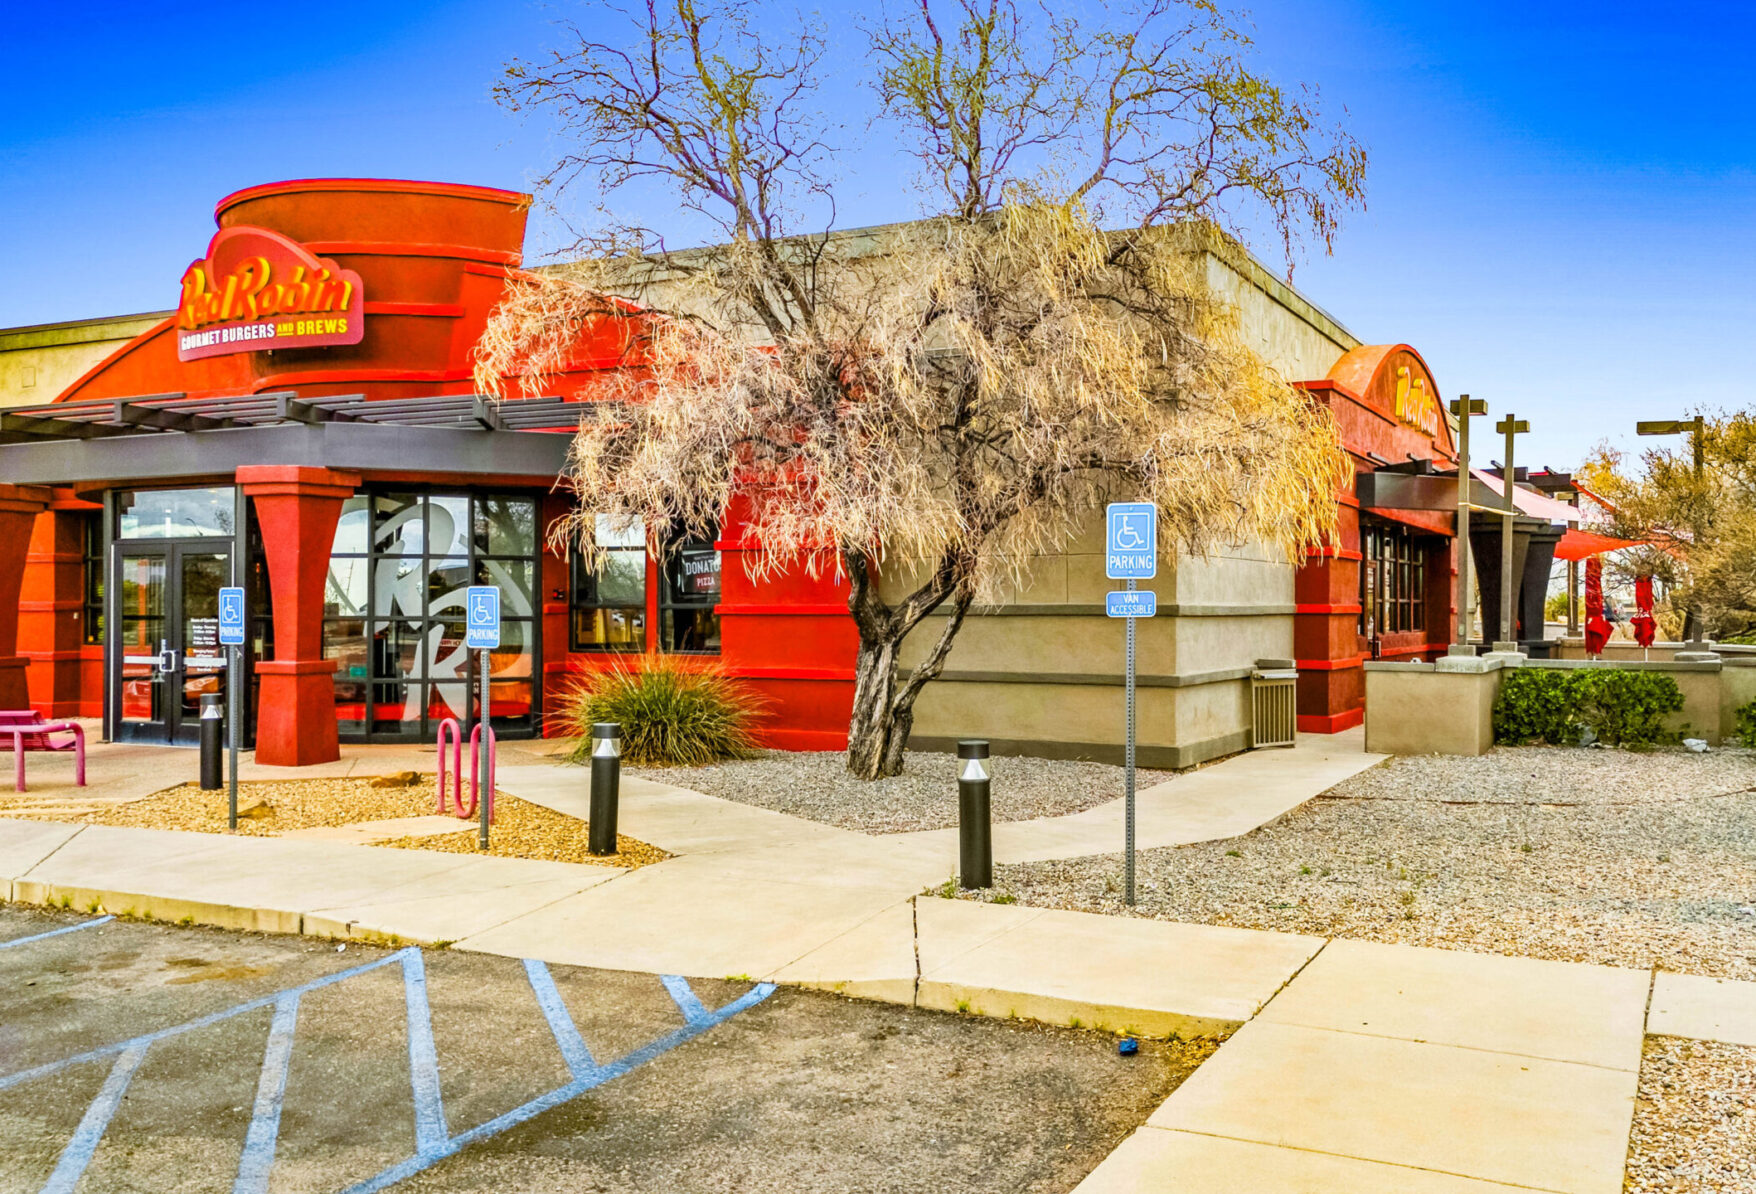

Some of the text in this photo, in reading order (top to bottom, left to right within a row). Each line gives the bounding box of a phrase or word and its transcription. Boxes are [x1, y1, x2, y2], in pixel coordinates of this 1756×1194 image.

[177, 256, 352, 330] Red Robin
[181, 319, 348, 351] GOURMET BURGERS AND BREWS
[1109, 555, 1153, 569] PARKING
[696, 576, 715, 588] PIZZA
[1123, 594, 1139, 603] VAN
[1110, 604, 1153, 615] ACCESSIBLE
[220, 626, 244, 637] PARKING
[469, 628, 498, 641] PARKING
